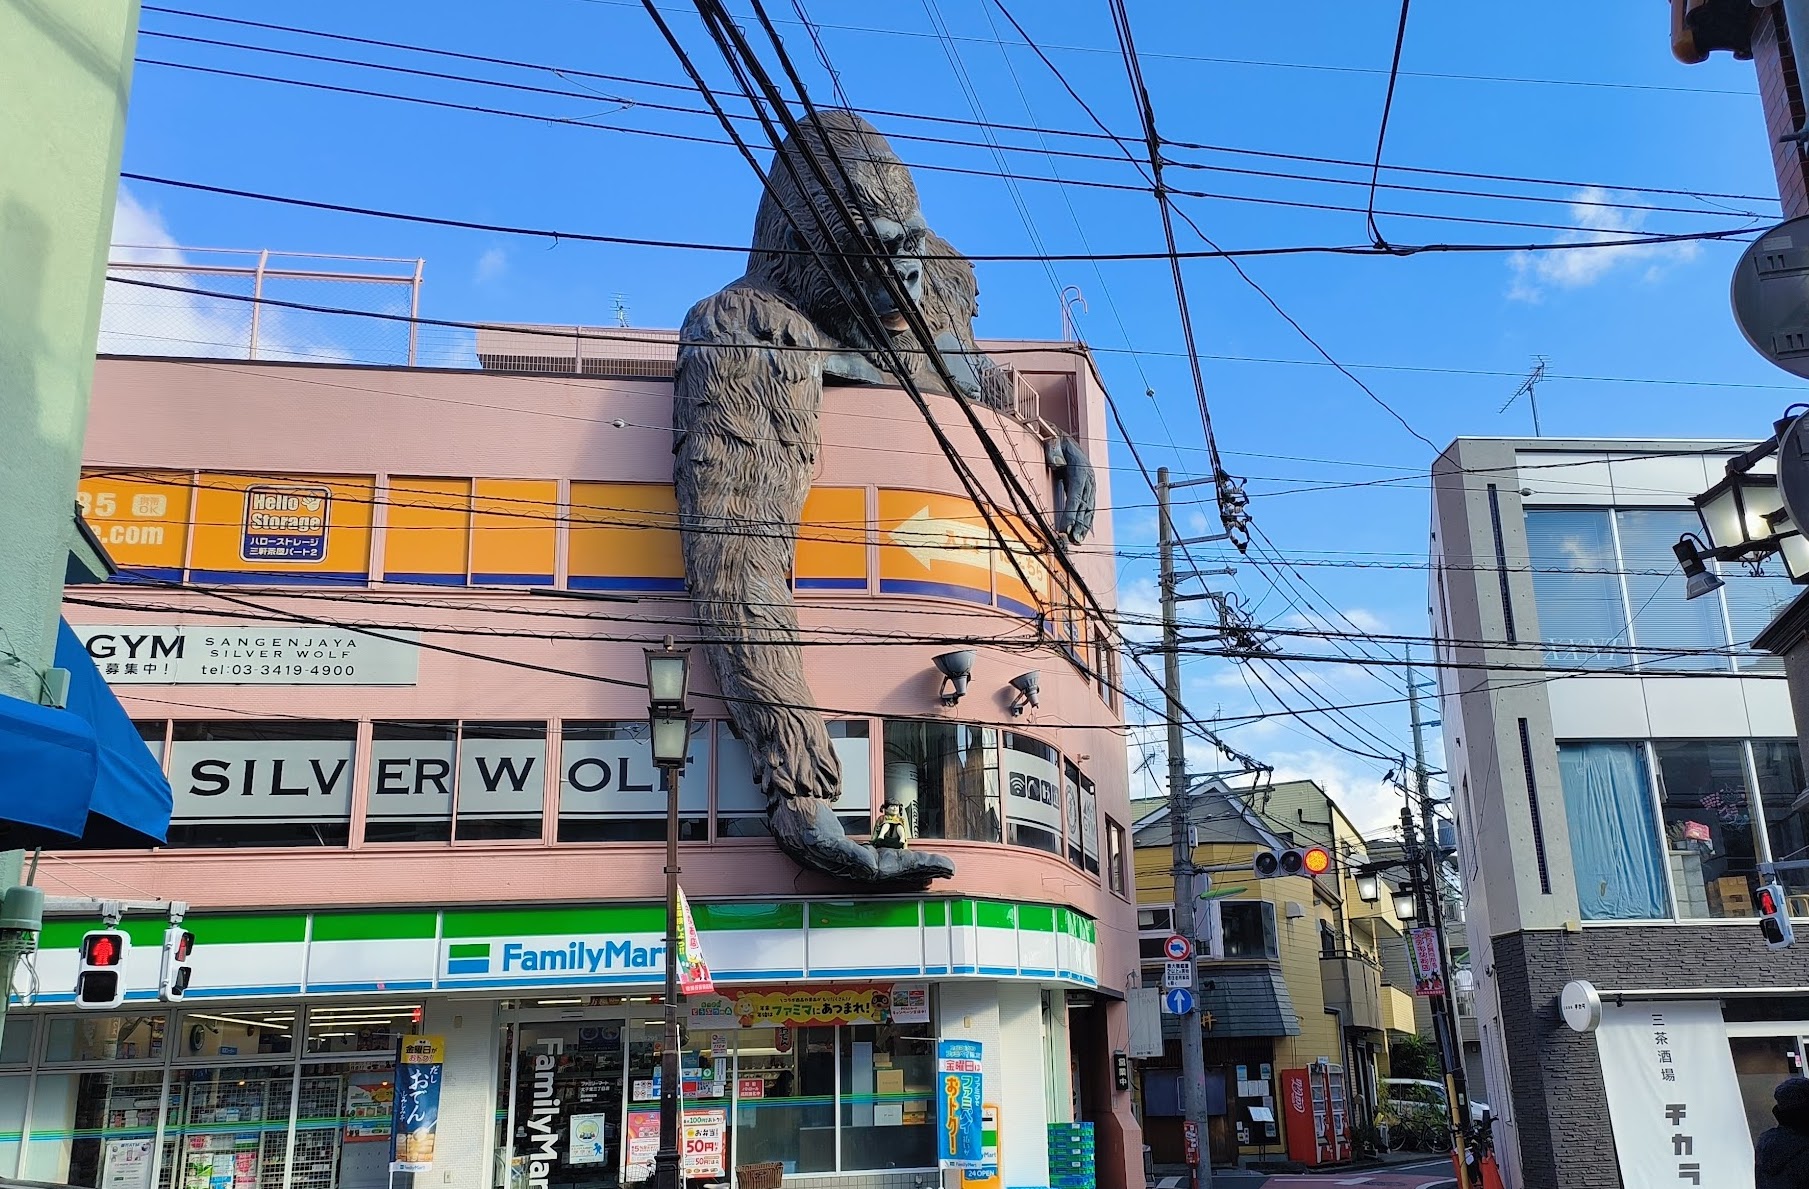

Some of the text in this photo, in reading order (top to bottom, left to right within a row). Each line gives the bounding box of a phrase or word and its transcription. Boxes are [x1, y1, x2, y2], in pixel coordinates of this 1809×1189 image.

[253, 493, 300, 511] Hello
[251, 512, 321, 532] Storage
[250, 537, 319, 547] ハローストレージ
[86, 634, 186, 659] GYM
[205, 637, 357, 648] SANGENJAYA
[210, 649, 350, 659] SILVER WOLF
[96, 663, 168, 675] 募集中!
[201, 664, 355, 676] tel:03-3419-4900
[189, 757, 451, 797] SILVER
[503, 940, 667, 972] FamilyMar
[1651, 1014, 1676, 1082] 三茶酒場
[430, 1065, 440, 1084] だし
[945, 1060, 981, 1072] 金曜日は
[406, 1068, 429, 1125] おでん
[527, 1038, 564, 1189] FamilyMar
[1665, 1104, 1700, 1185] チカラ
